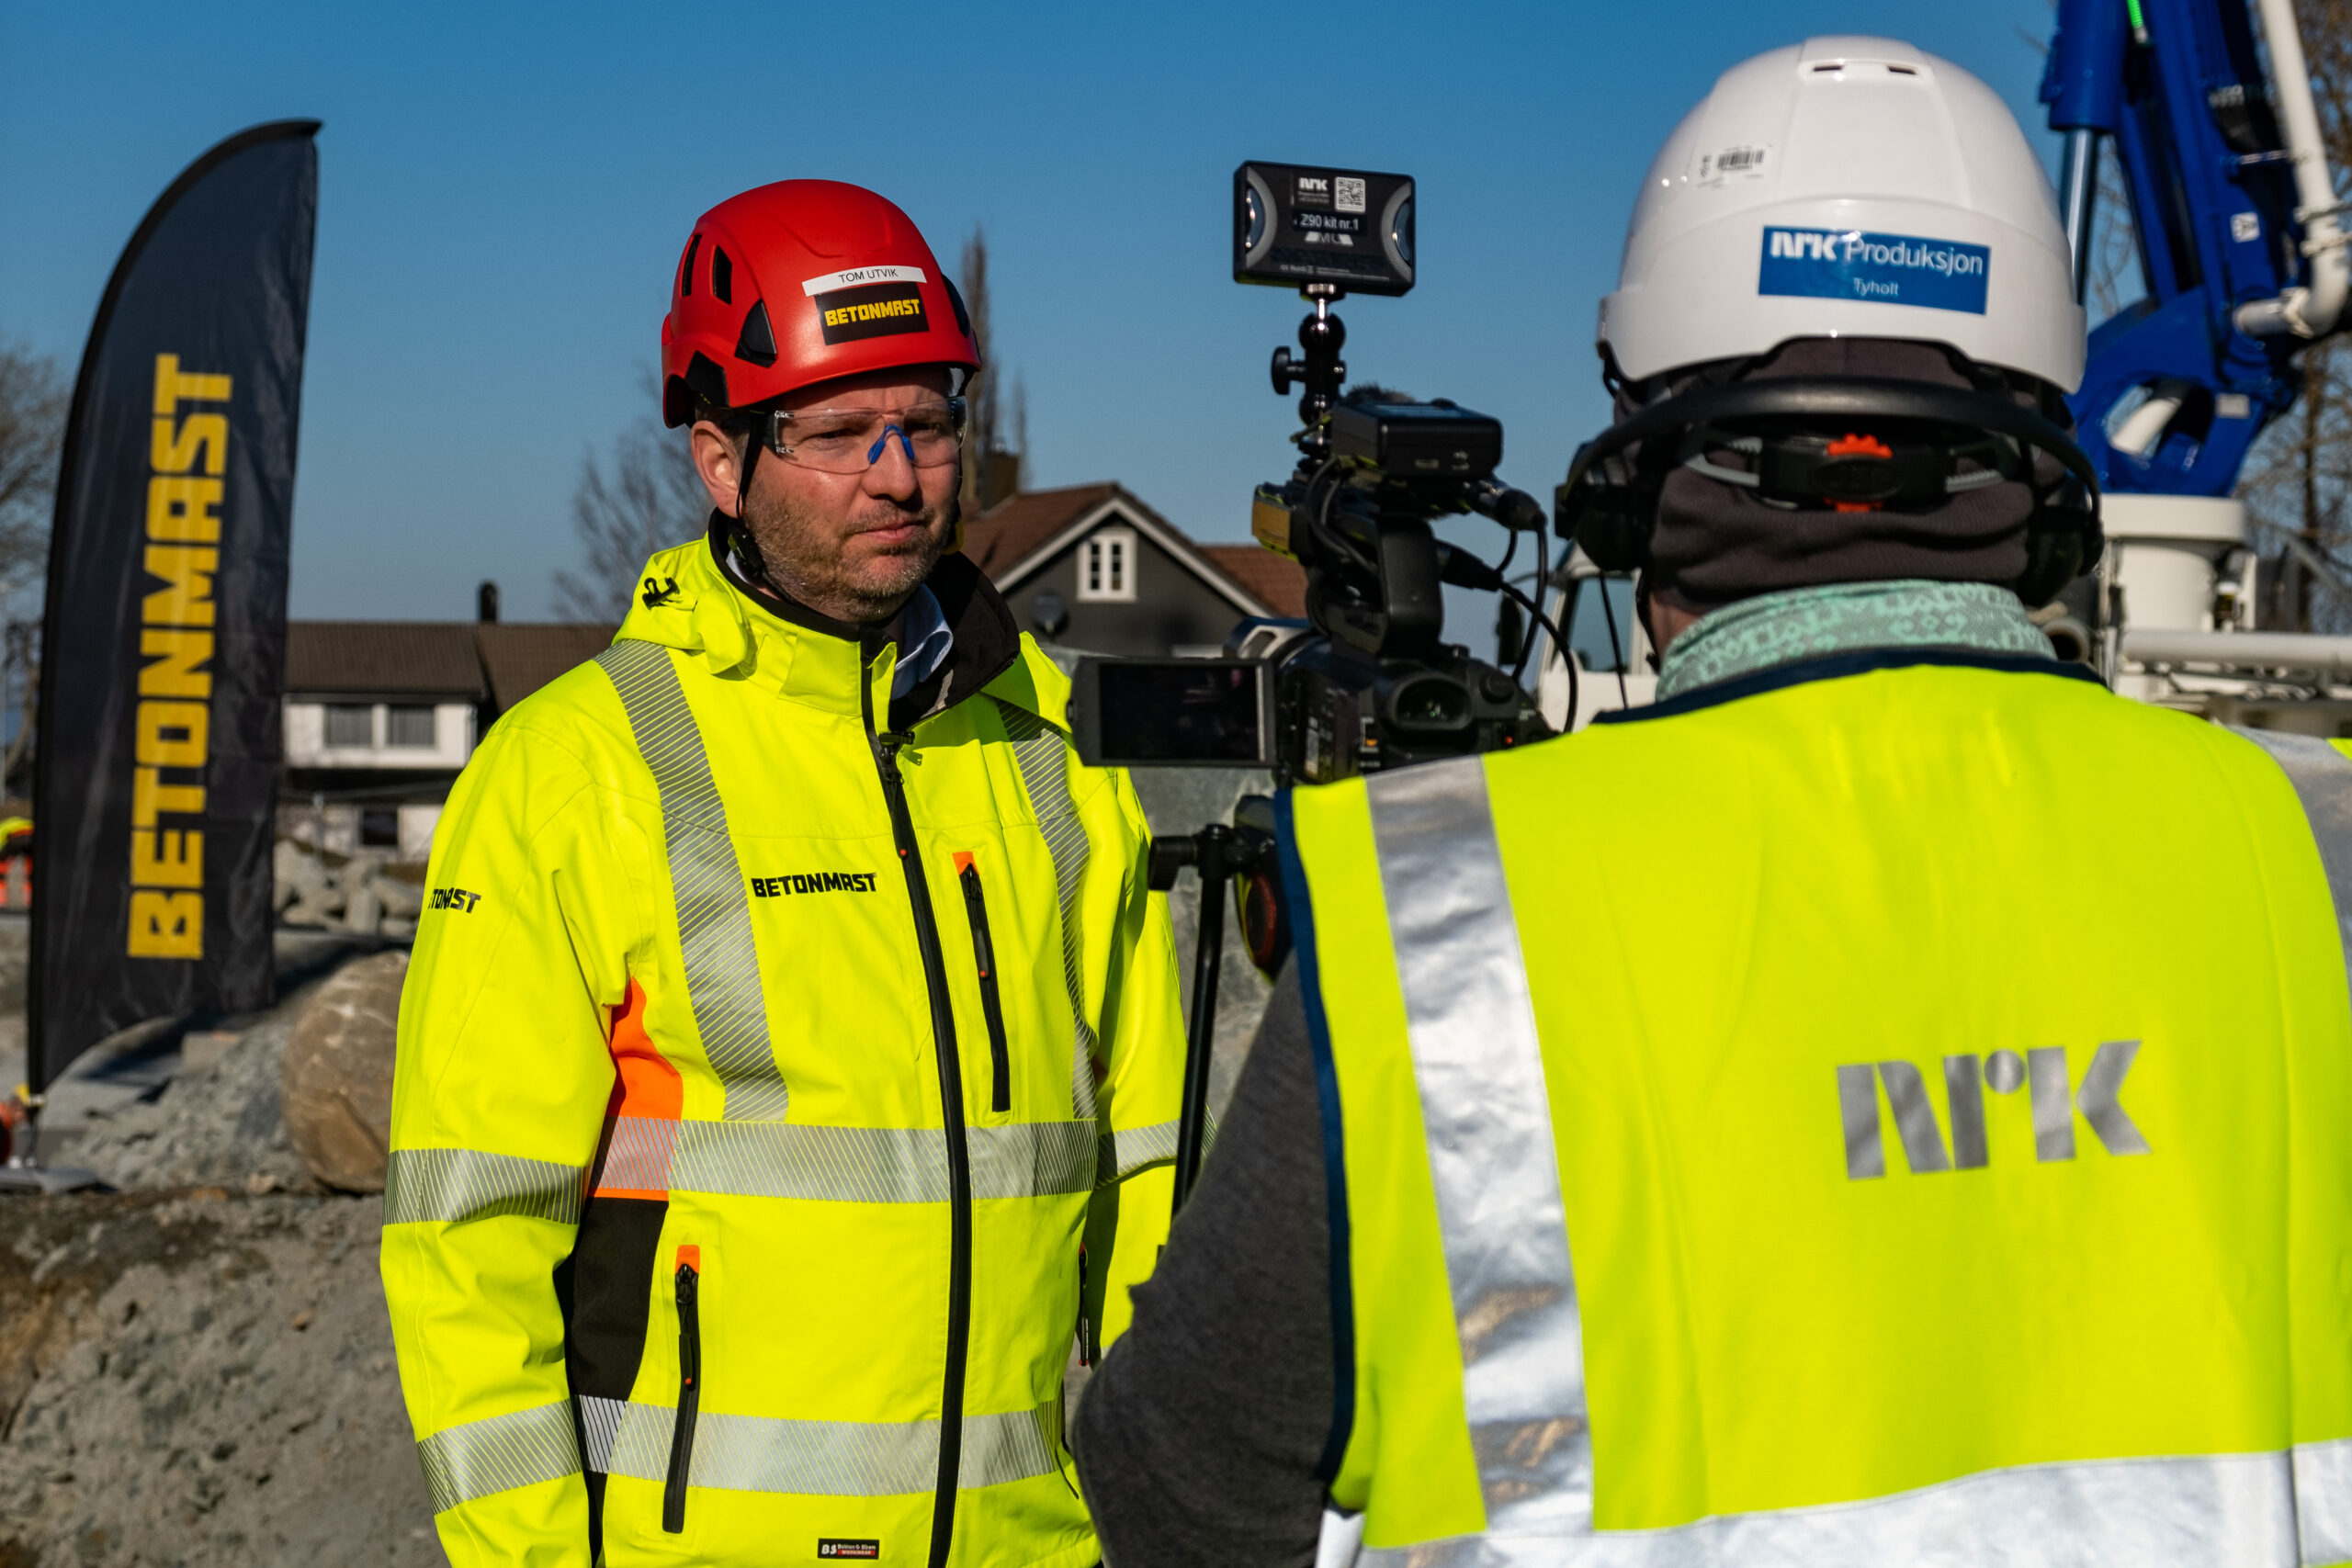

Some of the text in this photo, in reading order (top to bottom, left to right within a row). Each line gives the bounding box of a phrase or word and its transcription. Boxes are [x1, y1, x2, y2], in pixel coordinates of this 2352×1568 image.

[1300, 213, 1322, 228] Z90
[1324, 215, 1337, 229] kit
[1844, 235, 1984, 277] Produksjon
[838, 268, 899, 284] TOM UTVIK
[1853, 277, 1899, 297] Tyholt
[824, 299, 920, 327] BETONMAST
[127, 353, 233, 962] BETONMAST
[751, 872, 877, 897] BETONMAST
